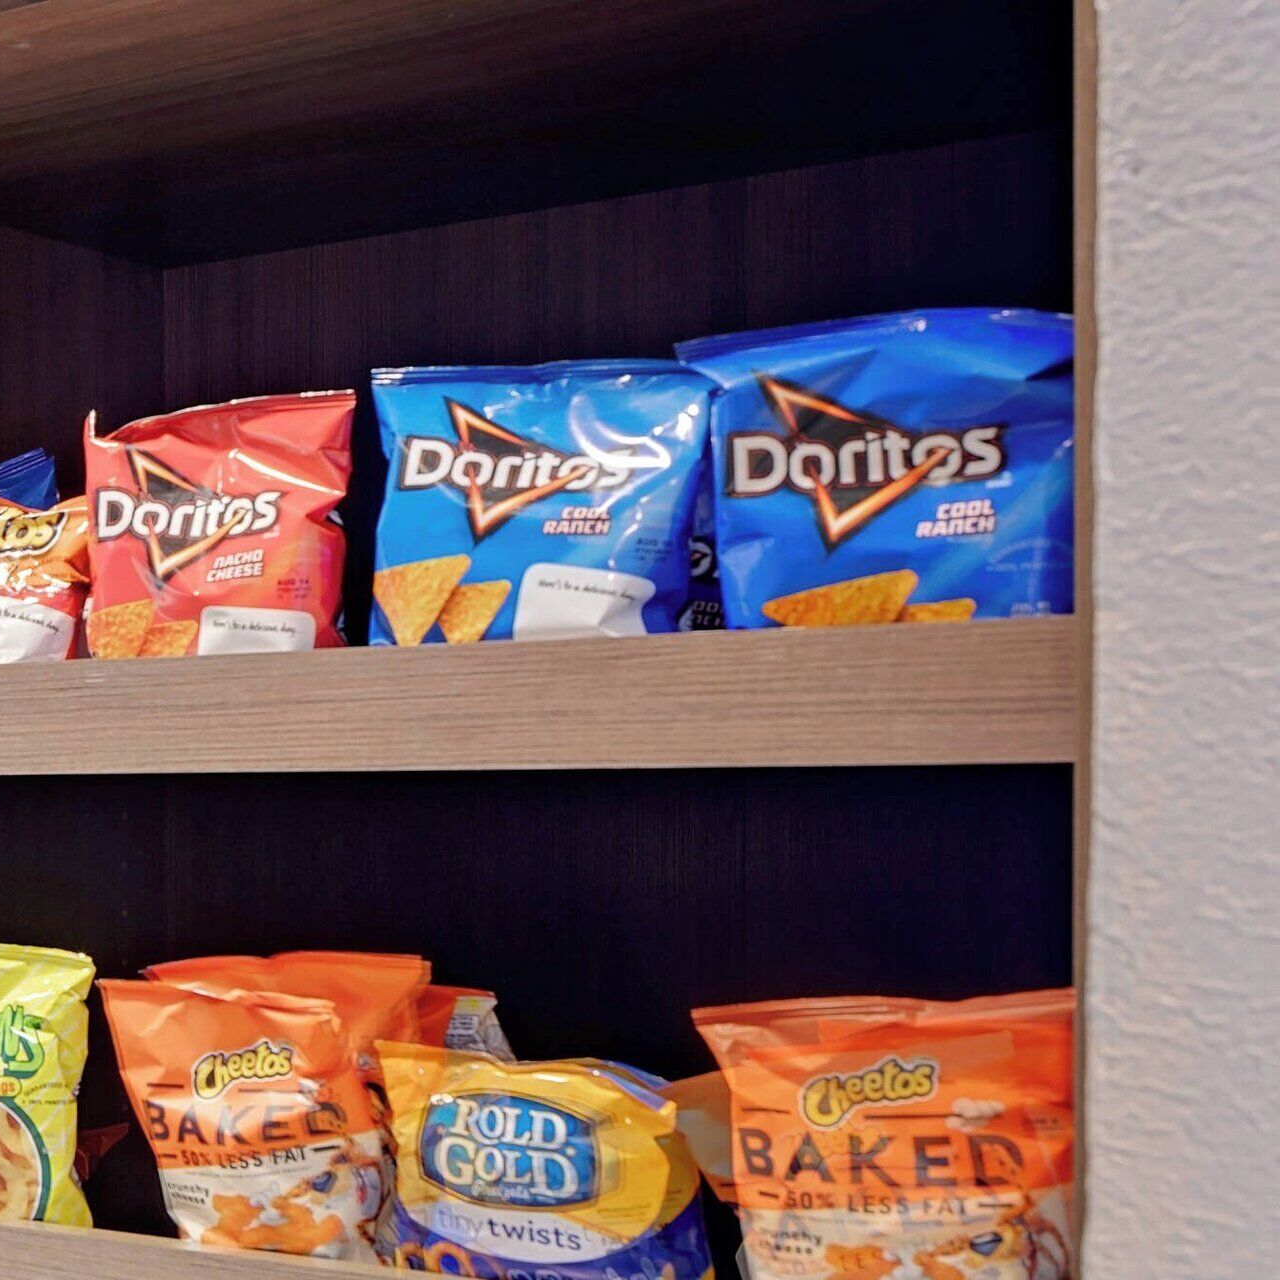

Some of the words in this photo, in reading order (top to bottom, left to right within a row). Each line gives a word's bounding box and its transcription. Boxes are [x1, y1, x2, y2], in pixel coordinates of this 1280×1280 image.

[404, 437, 635, 491] Doritos
[733, 426, 1002, 494] Doritos
[96, 491, 280, 541] Doritos
[543, 519, 611, 536] RANCH
[562, 506, 611, 521] COOL
[915, 514, 996, 538] RANCH
[936, 499, 995, 520] COOL
[206, 563, 264, 583] CHEESE
[214, 549, 263, 570] NACHO
[194, 1042, 293, 1098] Cheetos
[803, 1058, 935, 1127] Cheetos
[147, 1101, 348, 1145] BAKED
[455, 1099, 567, 1147] ROLD
[182, 1148, 213, 1167] 50%
[218, 1148, 263, 1168] LESS
[273, 1146, 308, 1165] FAT
[438, 1140, 578, 1199] GOLD
[738, 1127, 1025, 1188] BAKED
[786, 1188, 835, 1210] 50%
[848, 1191, 910, 1217] LESS
[922, 1195, 969, 1217] FAT
[438, 1208, 483, 1235] tiny
[488, 1217, 583, 1251] twists
